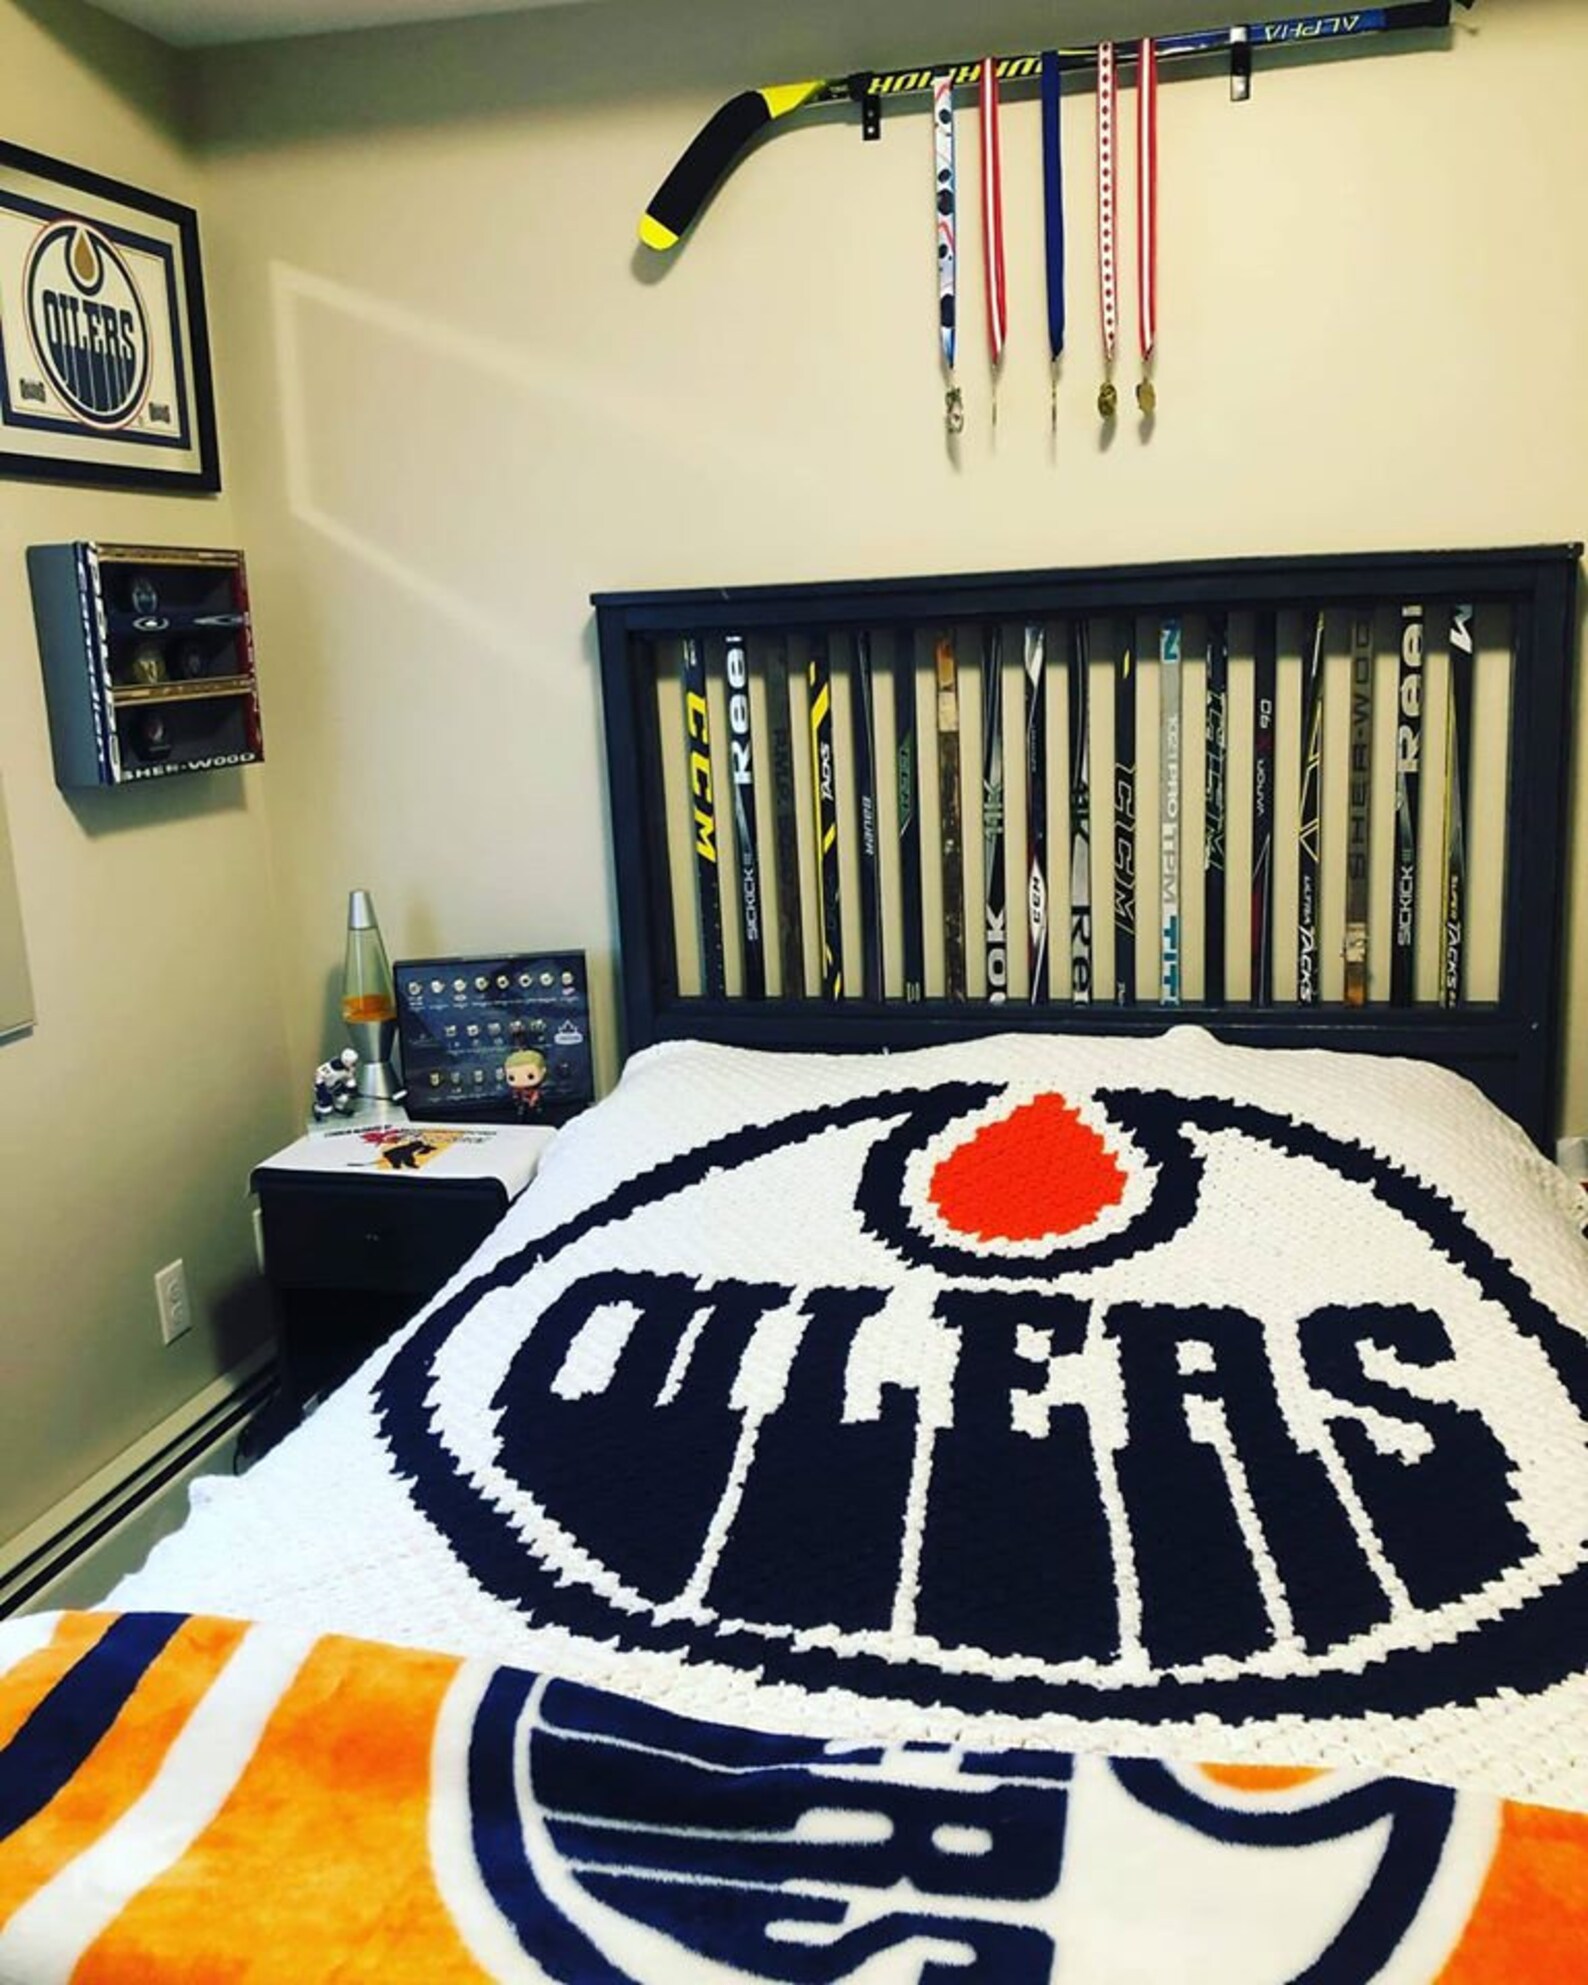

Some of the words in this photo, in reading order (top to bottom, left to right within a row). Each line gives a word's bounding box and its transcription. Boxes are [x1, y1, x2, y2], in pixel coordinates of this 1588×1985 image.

[1264, 15, 1360, 41] ALPHA
[687, 691, 717, 863] CCM
[1114, 763, 1137, 935] CCM
[1161, 915, 1180, 1004] TIT
